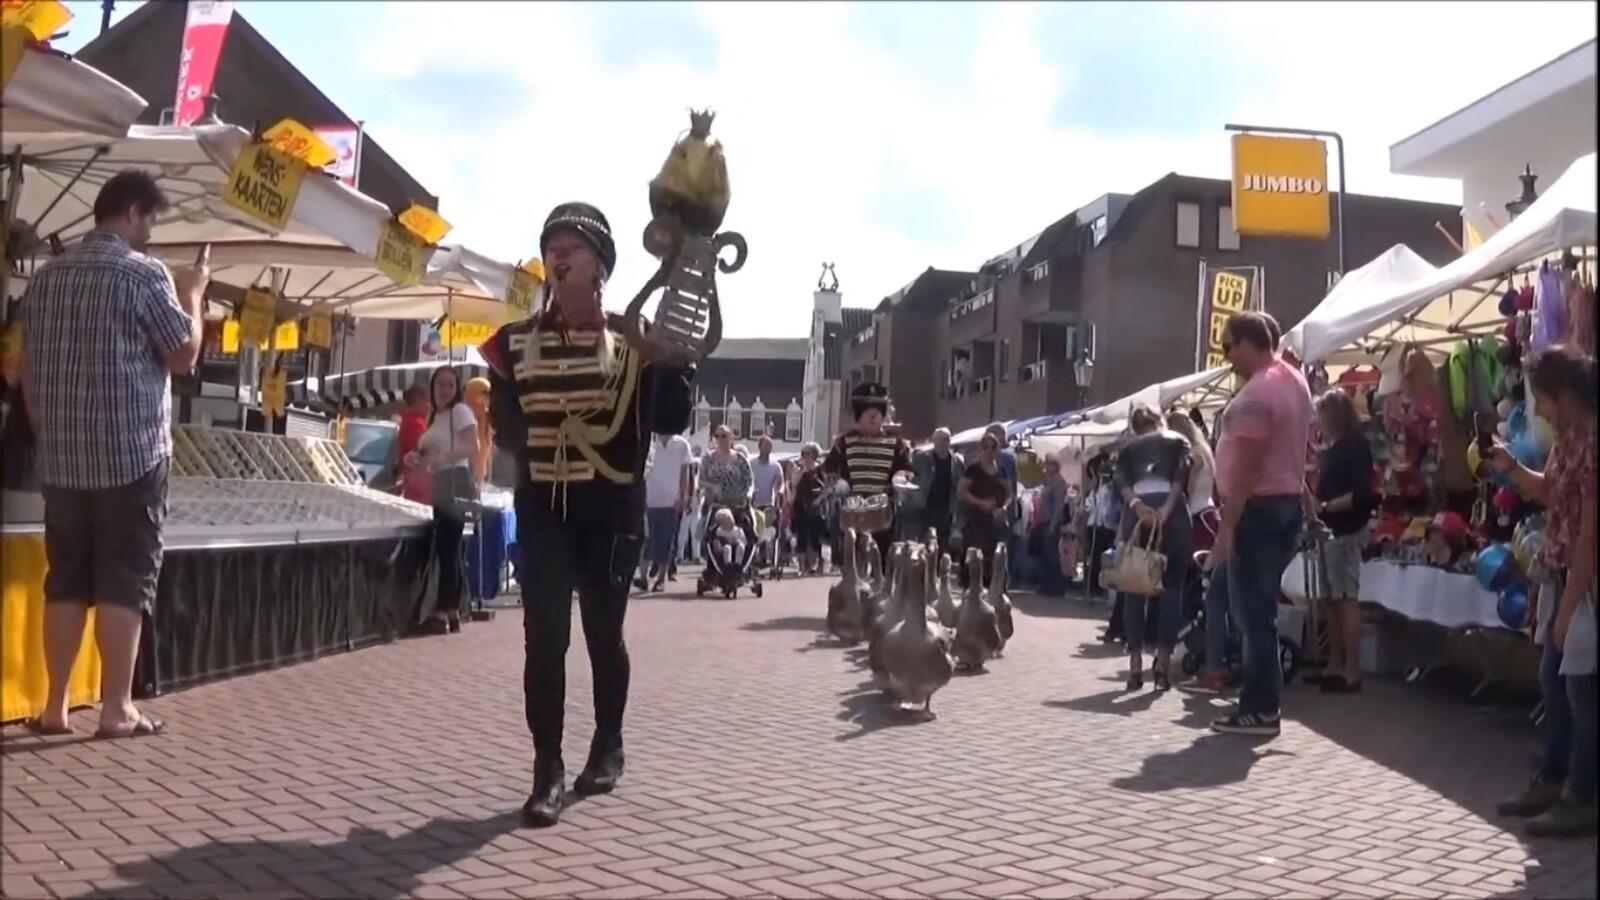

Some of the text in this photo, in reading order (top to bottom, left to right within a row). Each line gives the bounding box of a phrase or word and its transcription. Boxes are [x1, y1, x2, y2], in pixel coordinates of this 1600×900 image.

[232, 170, 289, 218] KAARTEN
[1243, 174, 1323, 195] JUMBO
[1219, 275, 1244, 289] PICK
[1217, 287, 1242, 307] UP
